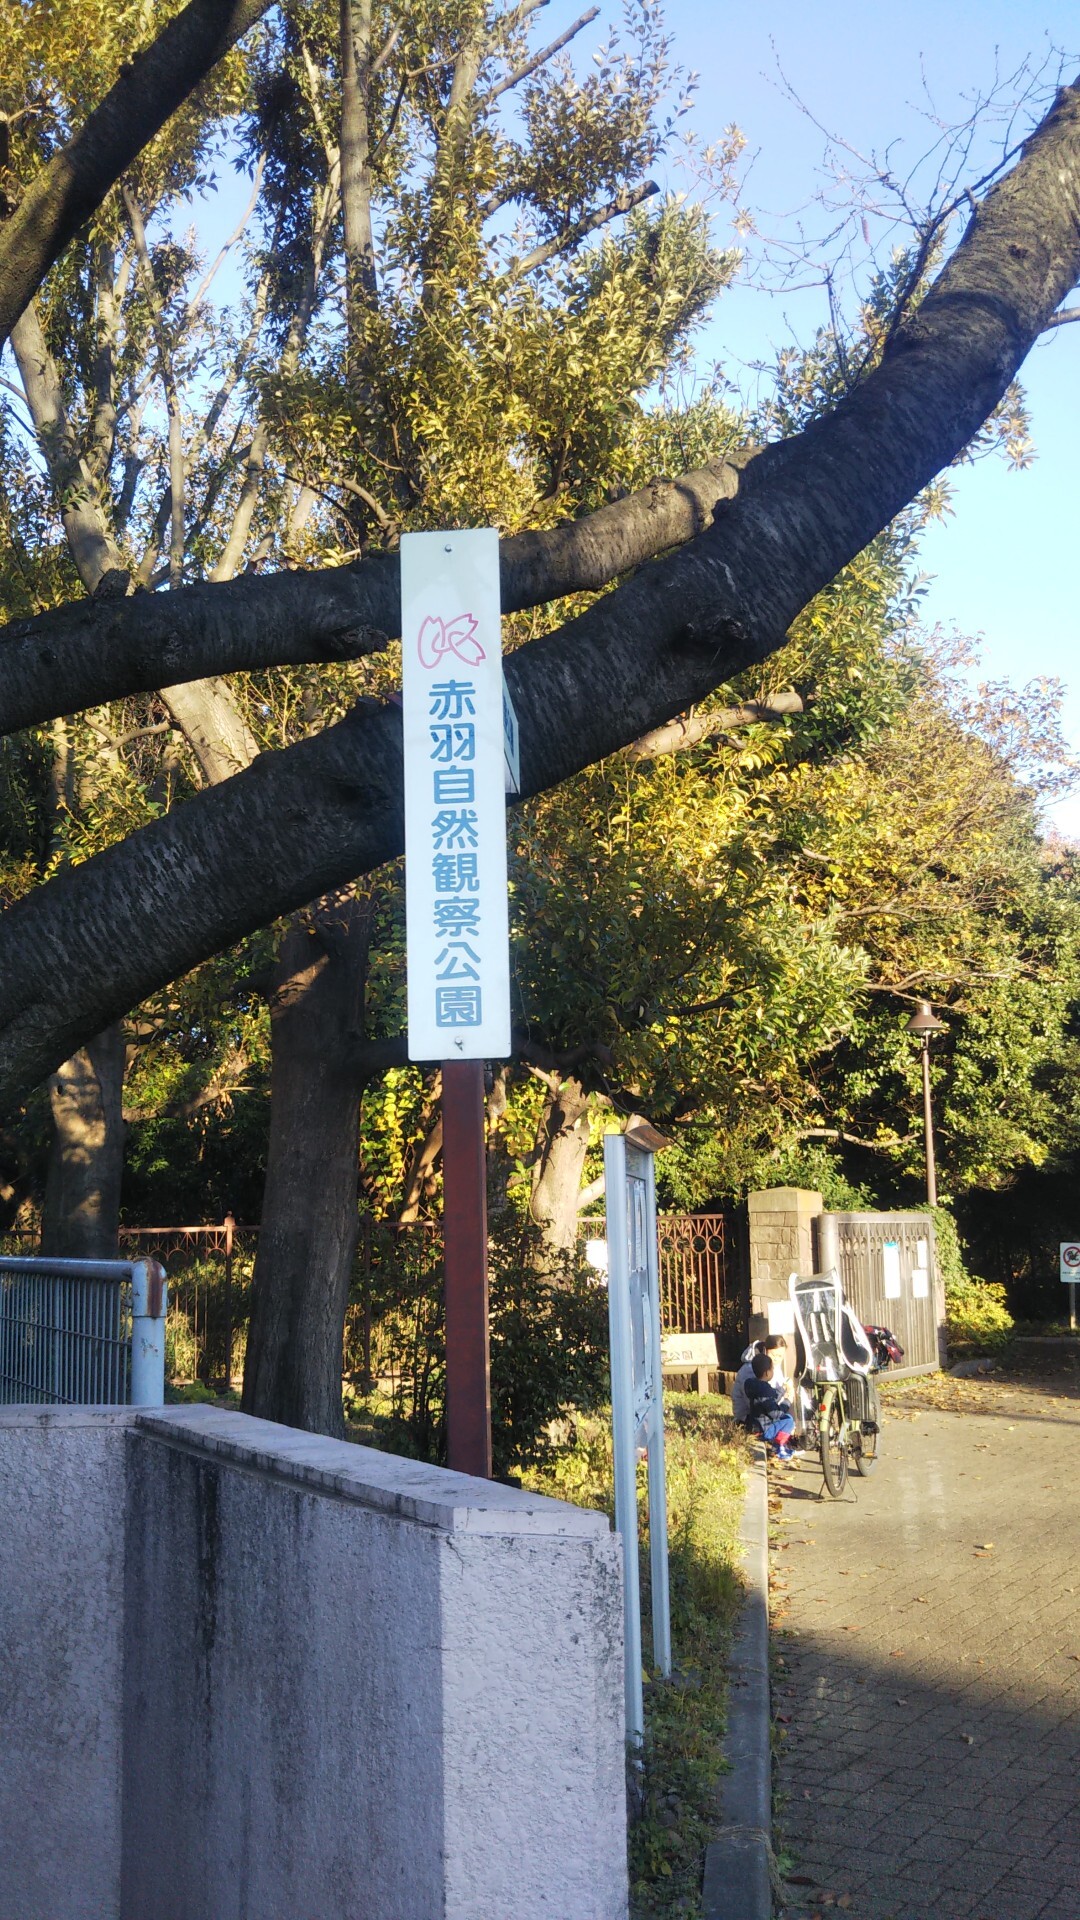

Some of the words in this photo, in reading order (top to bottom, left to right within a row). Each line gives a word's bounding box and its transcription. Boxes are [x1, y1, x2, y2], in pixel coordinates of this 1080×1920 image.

[428, 679, 482, 1028] 赤羽自然観察公園
